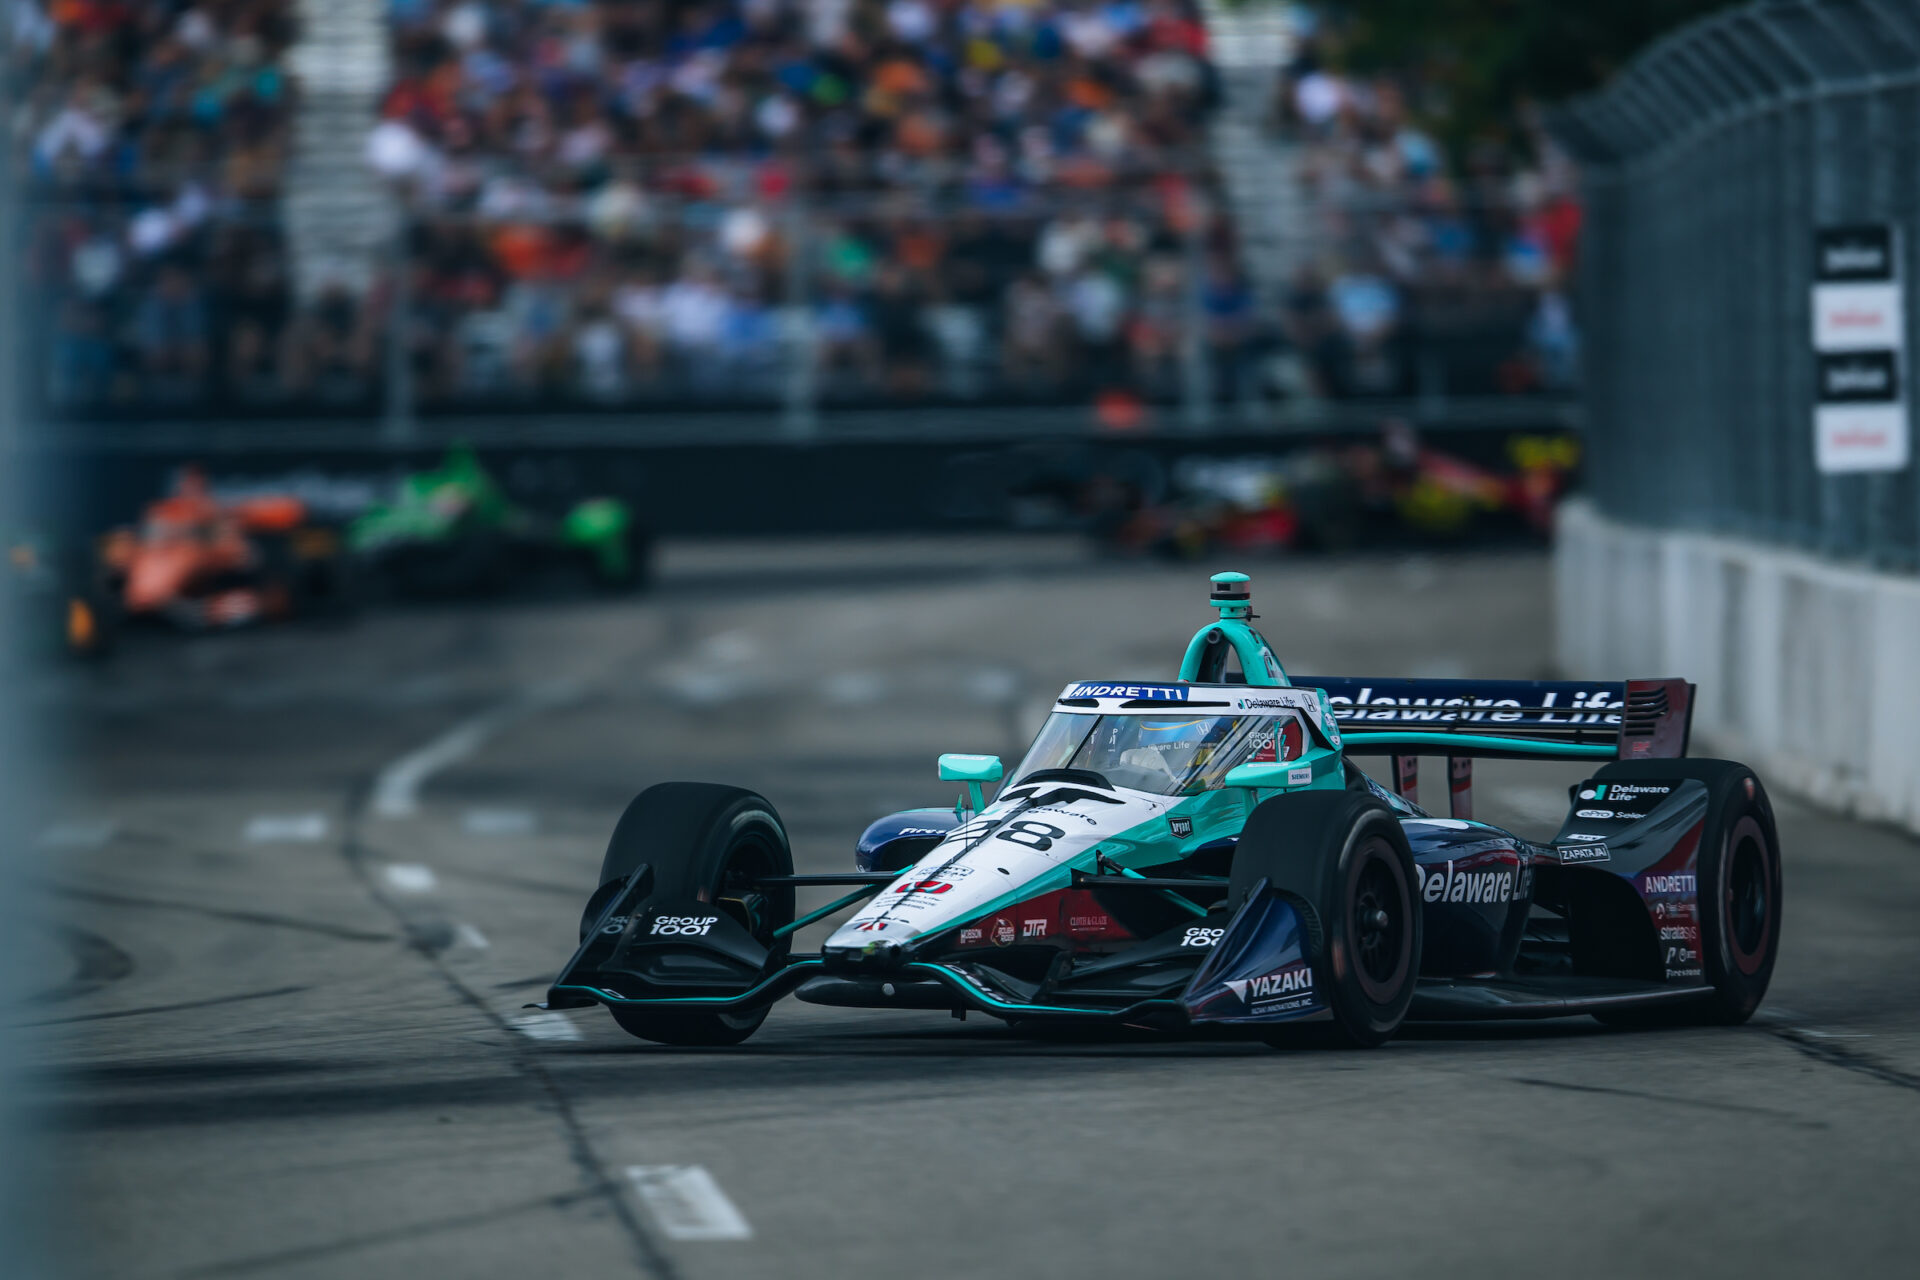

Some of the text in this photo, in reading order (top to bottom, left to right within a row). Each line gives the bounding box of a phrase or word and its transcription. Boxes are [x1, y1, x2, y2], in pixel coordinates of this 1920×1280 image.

[1070, 685, 1183, 700] ANDRETTI
[1244, 698, 1280, 709] Delaware
[1328, 687, 1523, 723] elaware
[1539, 691, 1624, 724] Life
[1248, 731, 1275, 739] GROU
[1611, 784, 1670, 793] Delaware
[1608, 792, 1633, 801] Life
[1036, 806, 1098, 826] laware
[1561, 849, 1594, 860] ZAPATA
[1645, 875, 1697, 893] ANDRETTI
[655, 915, 718, 926] GROUP
[649, 924, 712, 936] 1001
[1023, 918, 1047, 937] DTR
[1185, 927, 1225, 937] GRO
[1249, 967, 1313, 998] YAZAKI
